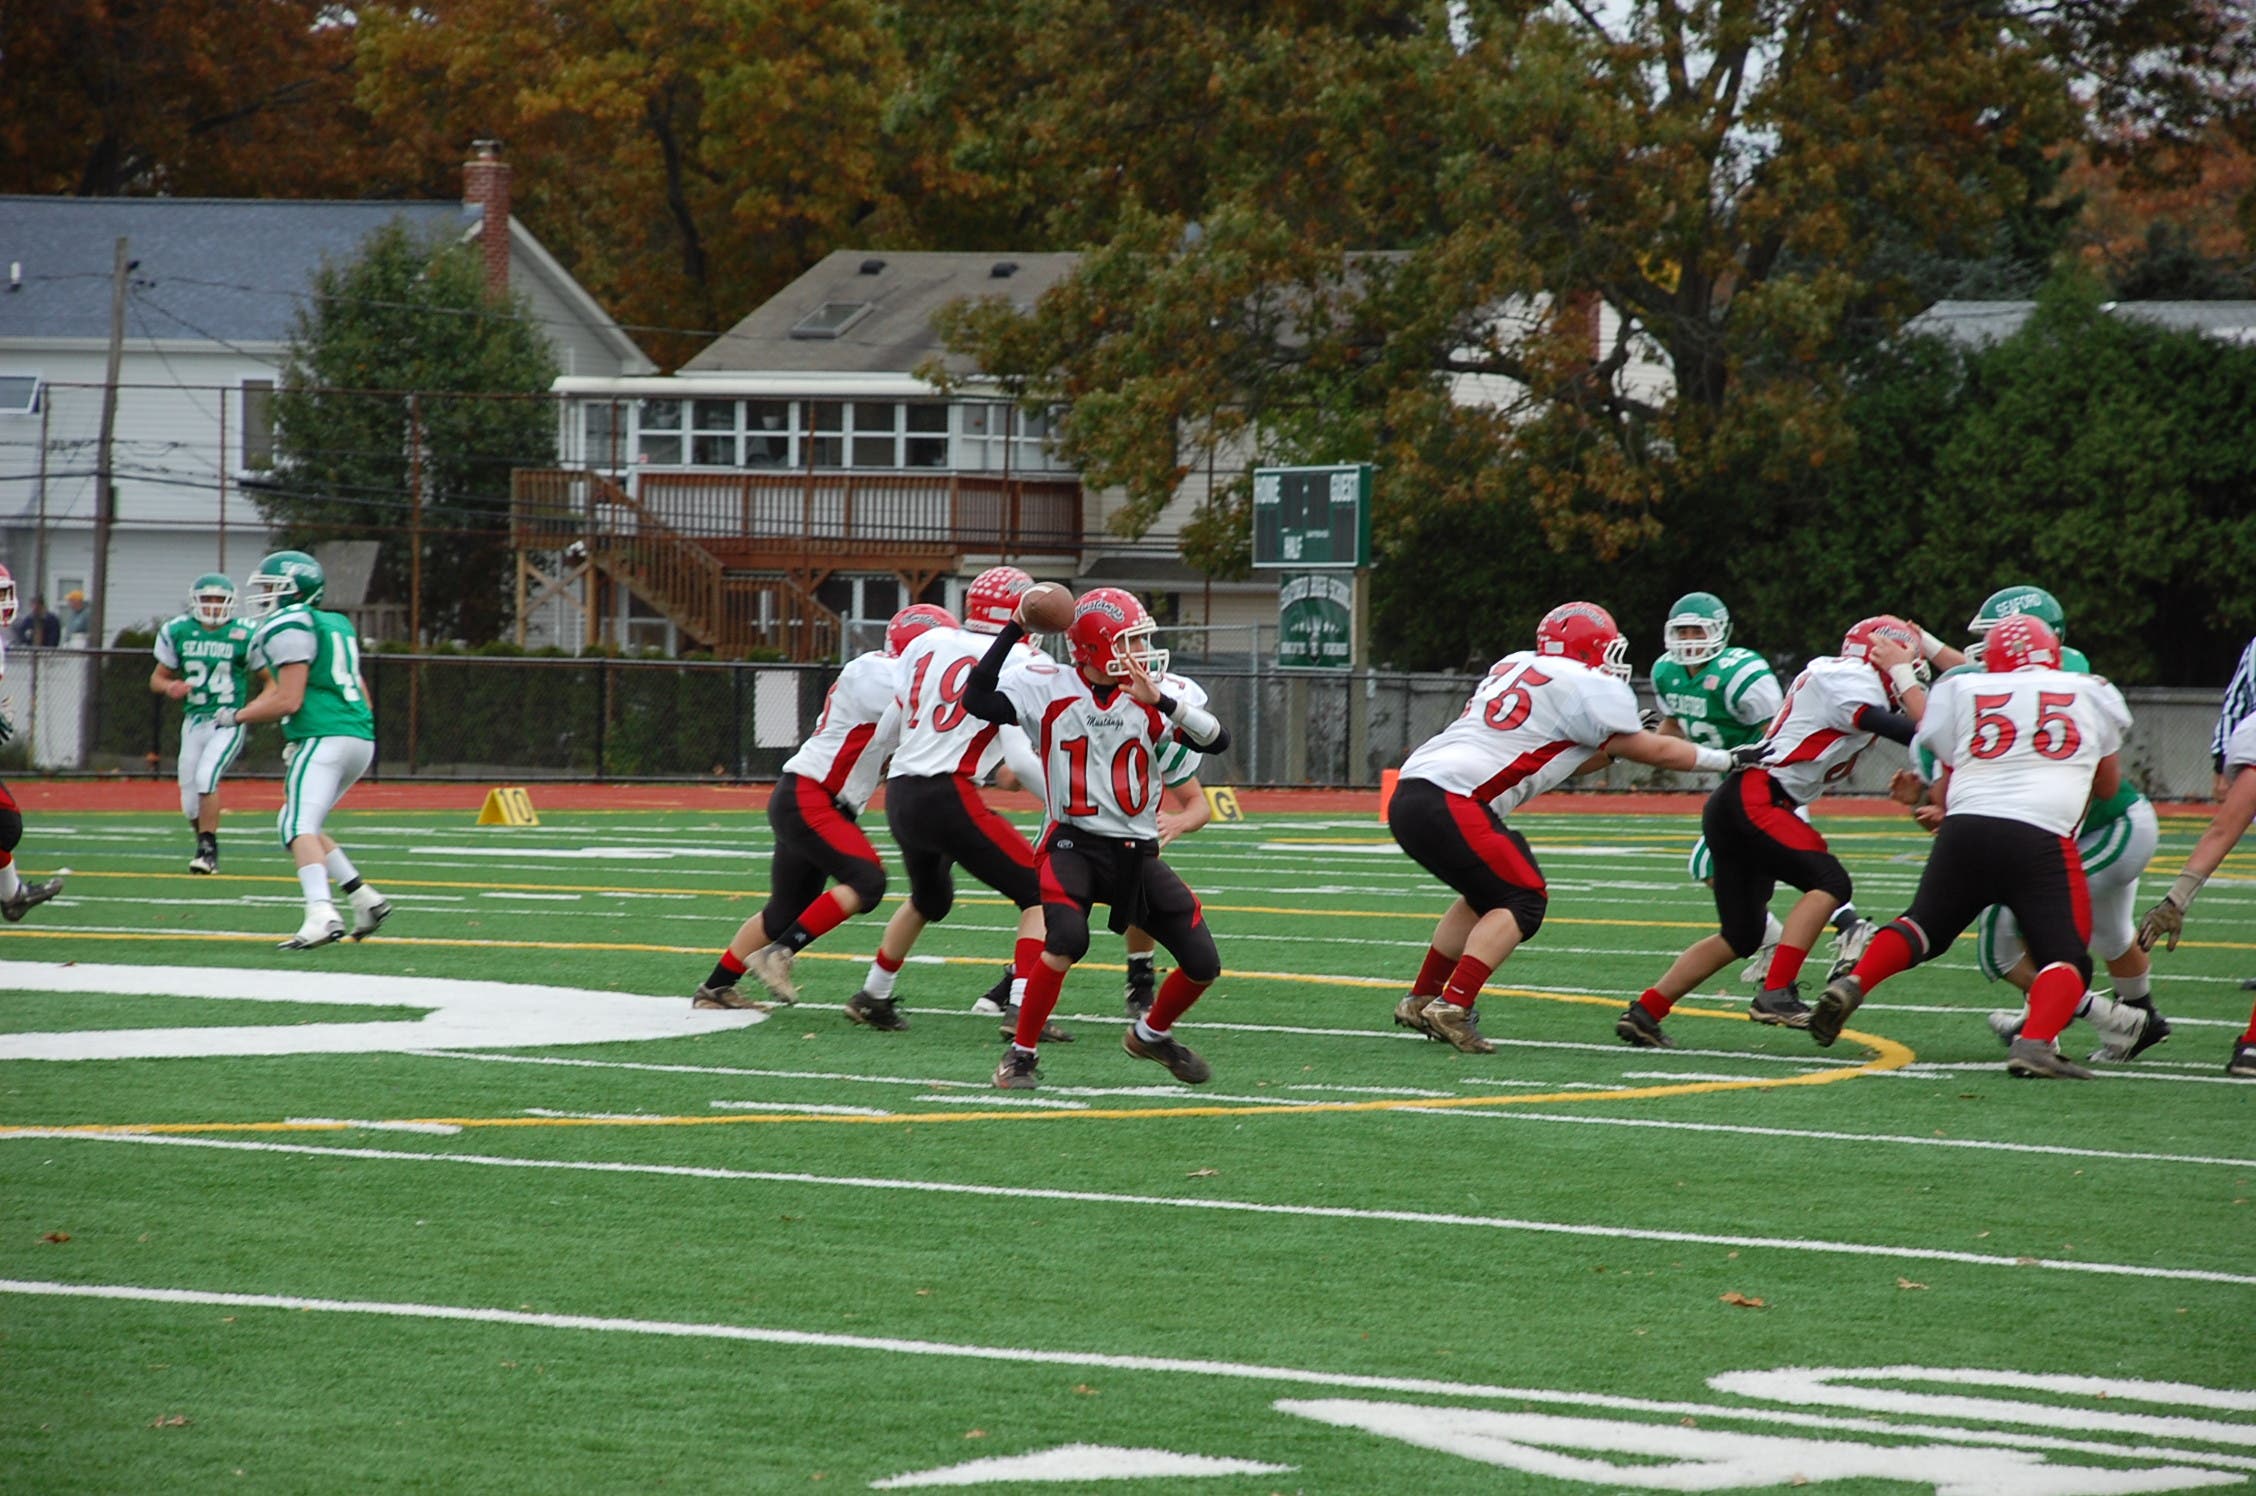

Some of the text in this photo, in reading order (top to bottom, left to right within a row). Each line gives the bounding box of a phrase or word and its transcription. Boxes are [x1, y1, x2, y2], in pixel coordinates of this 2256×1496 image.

[1995, 593, 2042, 617] SEAFORD
[182, 640, 235, 660] SEAFORD
[184, 660, 236, 705] 24
[908, 651, 980, 733] 19
[1086, 714, 1125, 733] Mustangs
[1969, 691, 2082, 760] 55
[1060, 735, 1151, 818] 10
[498, 788, 533, 824] 10
[1214, 791, 1238, 819] G
